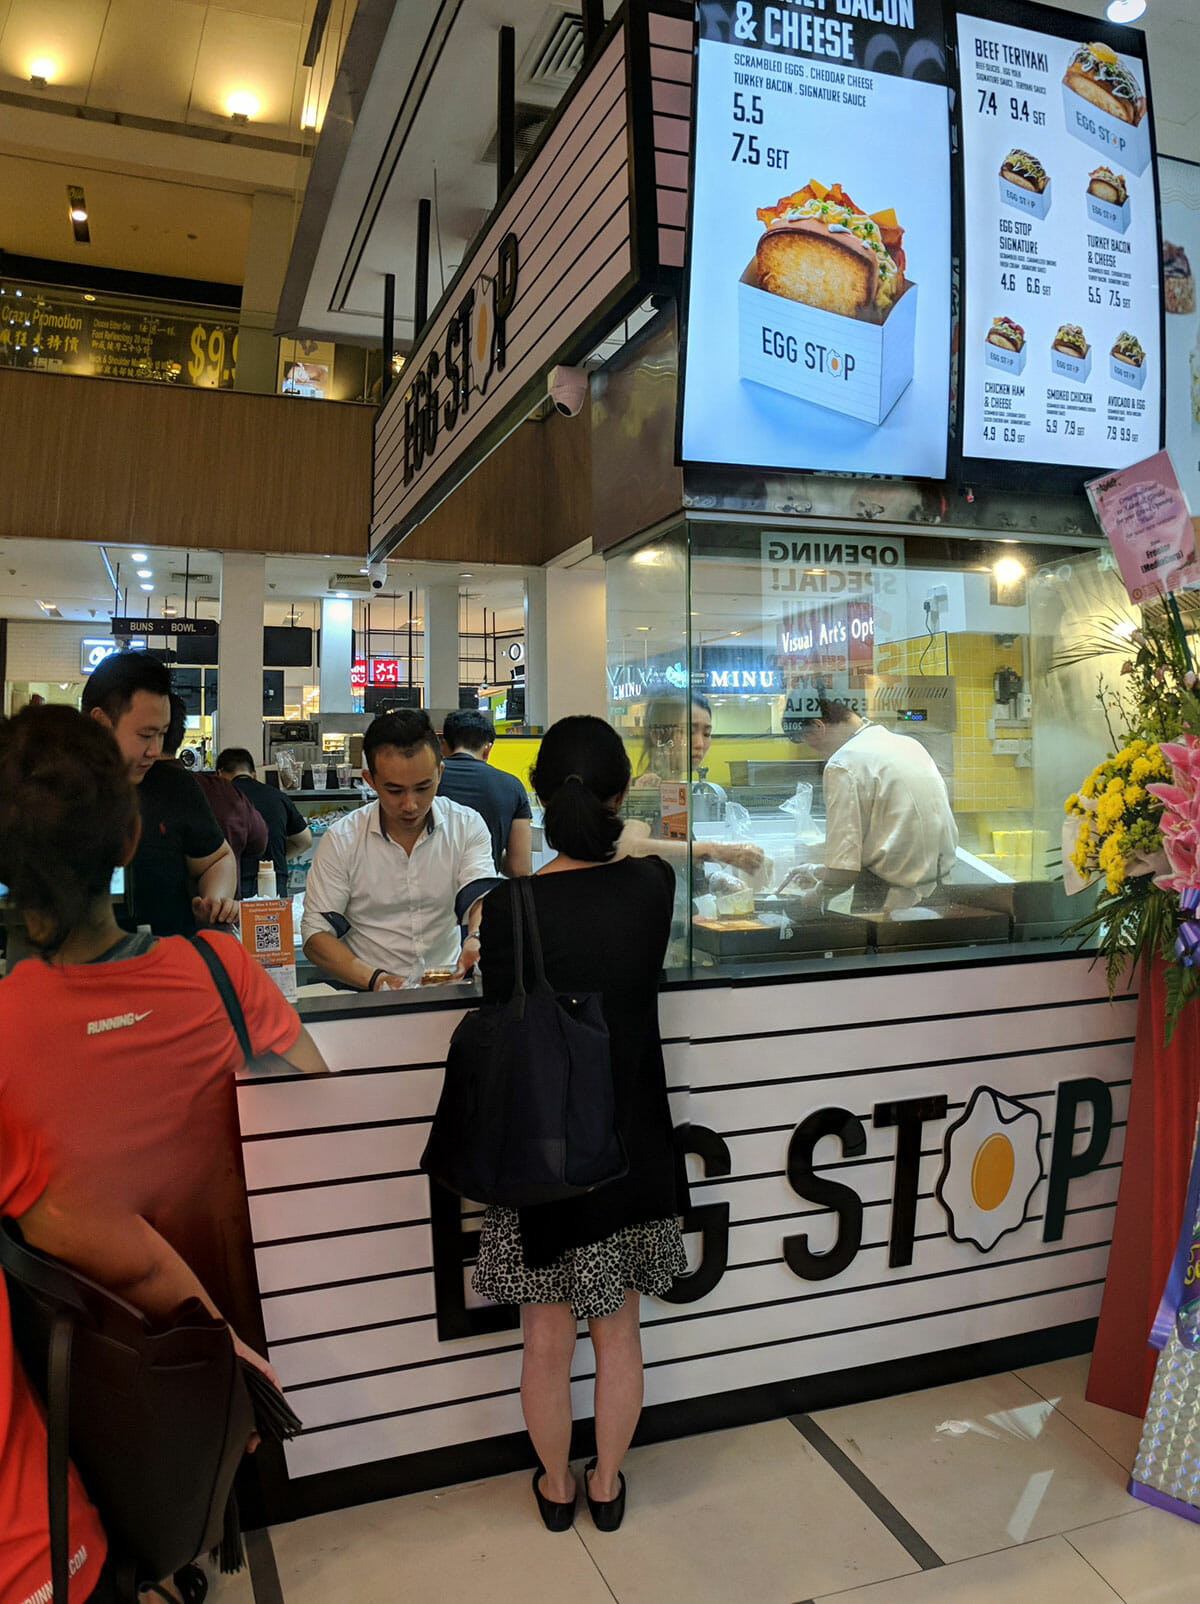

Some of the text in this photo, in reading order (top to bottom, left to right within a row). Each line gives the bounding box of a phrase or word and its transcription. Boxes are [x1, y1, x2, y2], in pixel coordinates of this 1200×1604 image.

[734, 1, 854, 60] & CHEESE
[975, 38, 1048, 73] BEEF TERIYAKI
[734, 53, 873, 90] SCRAMBLED EGGS CHEDDAR CHEESE
[734, 73, 866, 107] TURKEY BACON SIGNATURE SAUCE
[733, 93, 763, 125] 5.5
[978, 89, 1046, 126] 7.4 9.4 SET
[1076, 111, 1096, 134] EGG
[731, 132, 789, 170] 7.5 SET
[1000, 219, 1032, 236] EGG STOP
[1000, 236, 1038, 255] SIGNATURE
[1087, 234, 1131, 254] TURKEY BACON
[1094, 252, 1116, 268] CHEESE
[1001, 273, 1015, 291] 4.6
[1026, 277, 1040, 294] 6.6
[1088, 286, 1101, 304] 5.5
[1109, 290, 1121, 307] 7.5
[761, 326, 797, 363] EGG
[985, 382, 1025, 397] CHICKEN HAM
[1047, 388, 1092, 403] SMOKED CHICKEN
[991, 397, 1011, 410] CHEESE
[1107, 395, 1130, 408] AVOCADO
[404, 350, 439, 487] EGG
[1046, 419, 1057, 433] 5.9
[1064, 420, 1075, 435] 7.9
[984, 426, 995, 441] 4.9
[1004, 428, 1016, 442] 6.9
[1107, 426, 1117, 440] 7.9
[1120, 427, 1130, 441] 9.9
[130, 621, 196, 633] BUNS BOWL
[782, 630, 813, 653] Visual
[819, 621, 847, 646] Art's
[711, 670, 774, 688] MINU
[87, 1013, 135, 1035] RUNNING
[429, 1125, 731, 1342] EG
